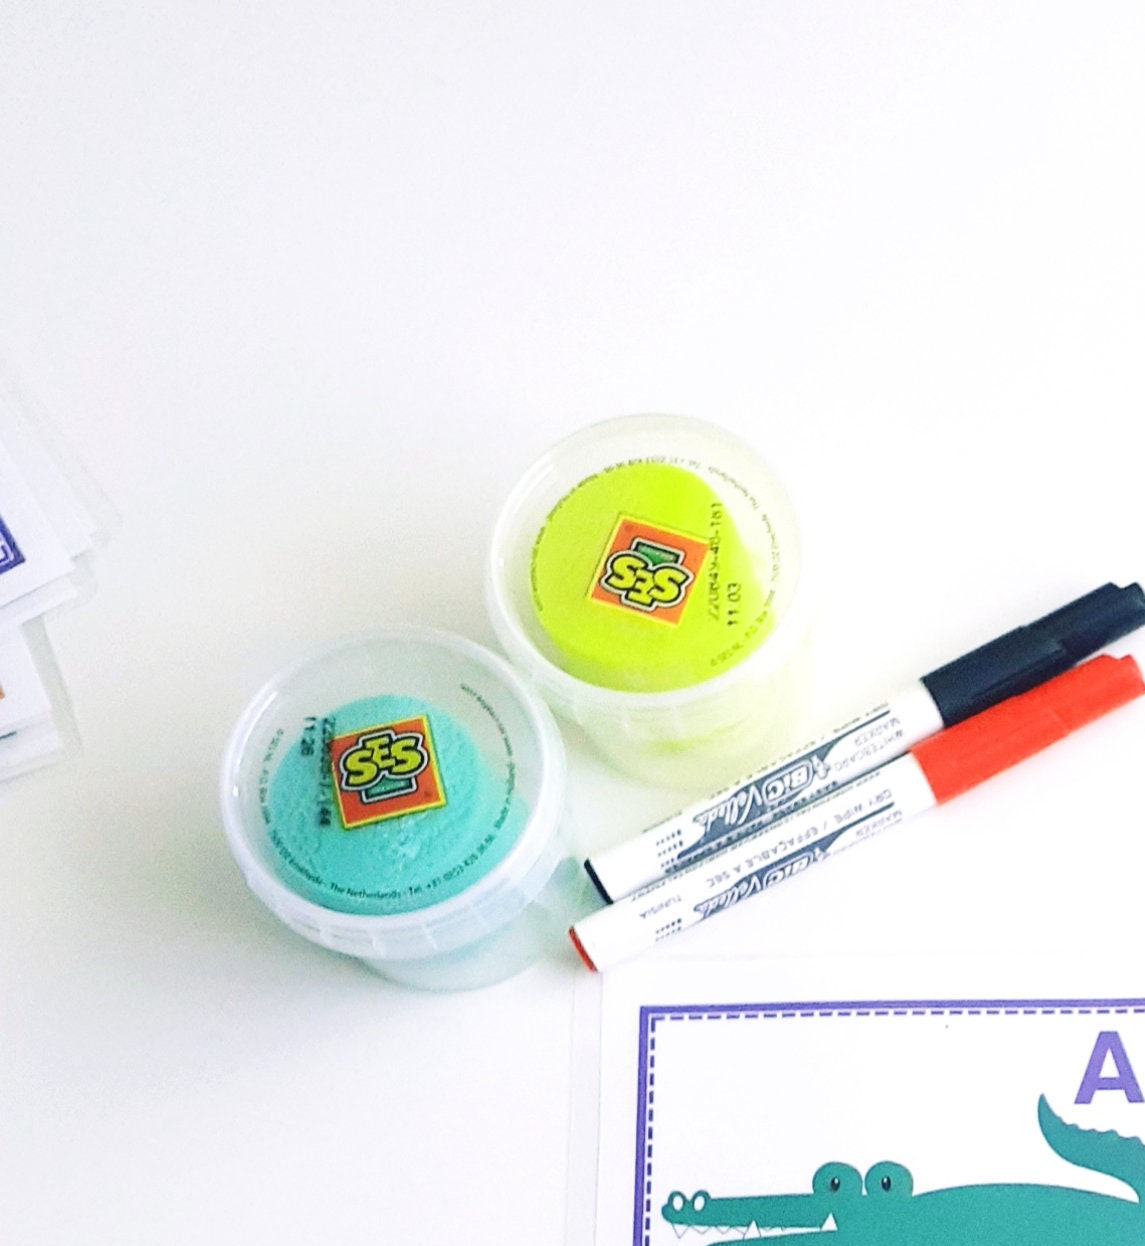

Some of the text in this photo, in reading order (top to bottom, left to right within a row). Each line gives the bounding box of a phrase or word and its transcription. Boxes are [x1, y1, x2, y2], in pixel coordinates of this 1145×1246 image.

[605, 552, 692, 607] SES
[342, 733, 426, 787] SES
[693, 784, 765, 836] Velleda
[1075, 1032, 1142, 1104] A
